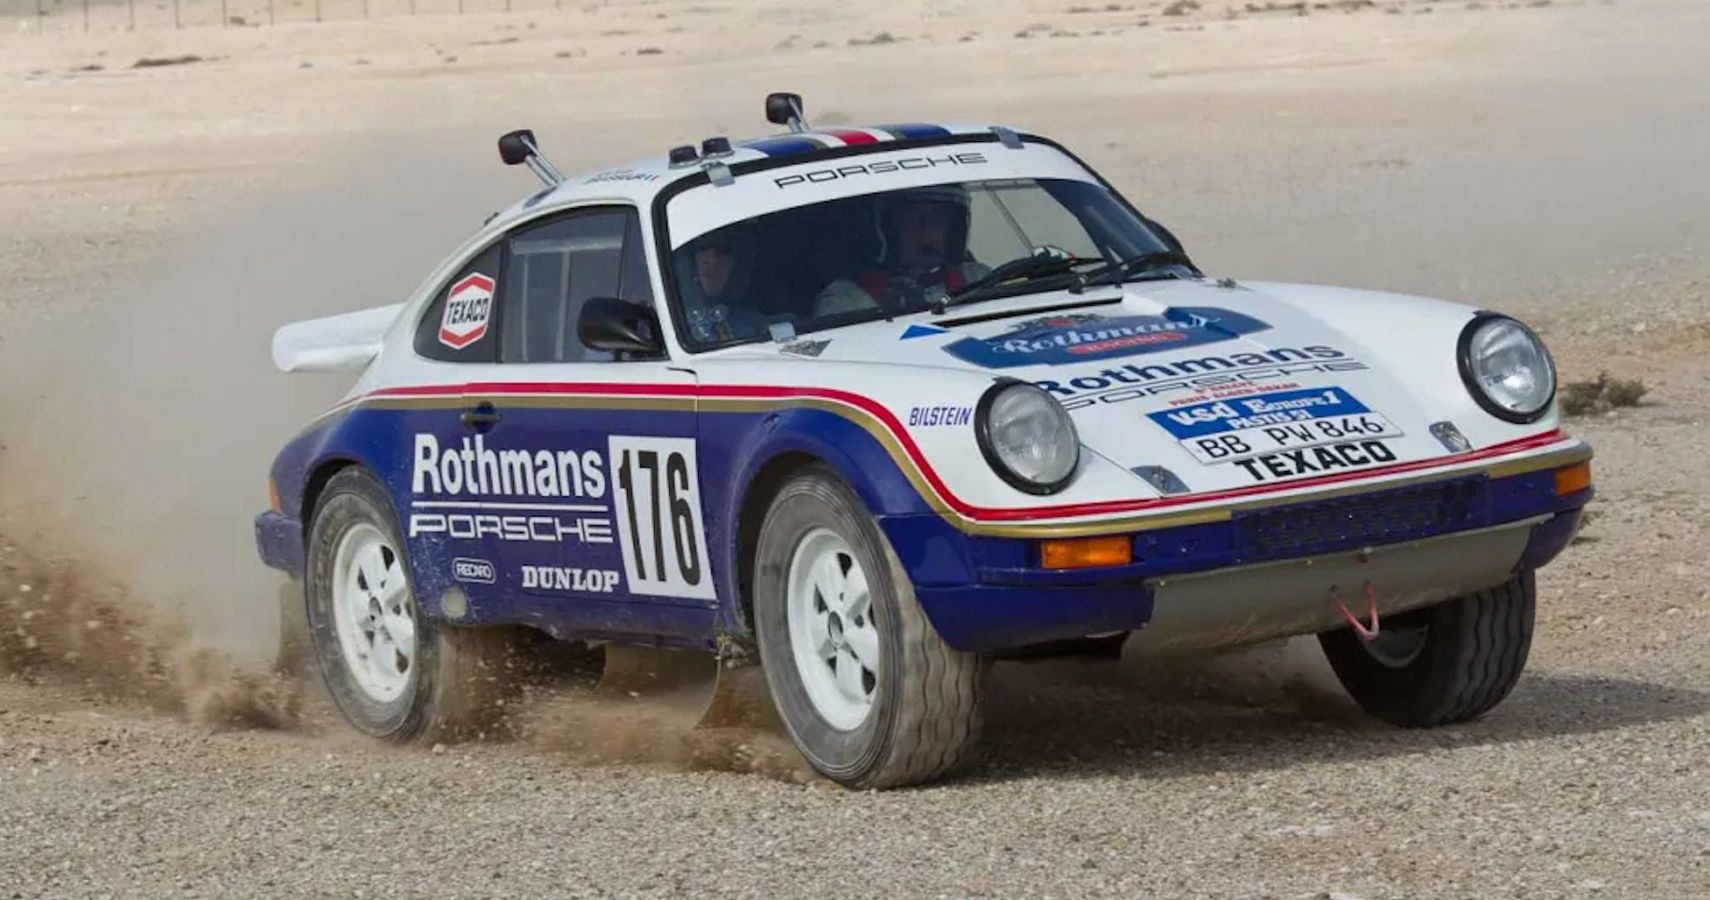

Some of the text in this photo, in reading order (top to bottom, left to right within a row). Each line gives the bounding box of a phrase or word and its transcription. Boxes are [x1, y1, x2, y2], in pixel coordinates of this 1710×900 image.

[774, 152, 988, 189] PORSCHE
[447, 297, 489, 325] TEXACO
[909, 406, 972, 426] BILSTEIN
[1196, 416, 1385, 459] BB PW 846
[412, 433, 606, 498] Rothmans
[1233, 441, 1397, 481] TEXACO
[409, 514, 614, 543] PORSCHE
[618, 449, 701, 586] 176
[456, 562, 492, 579] RECARO
[521, 565, 619, 592] DUNLOP
